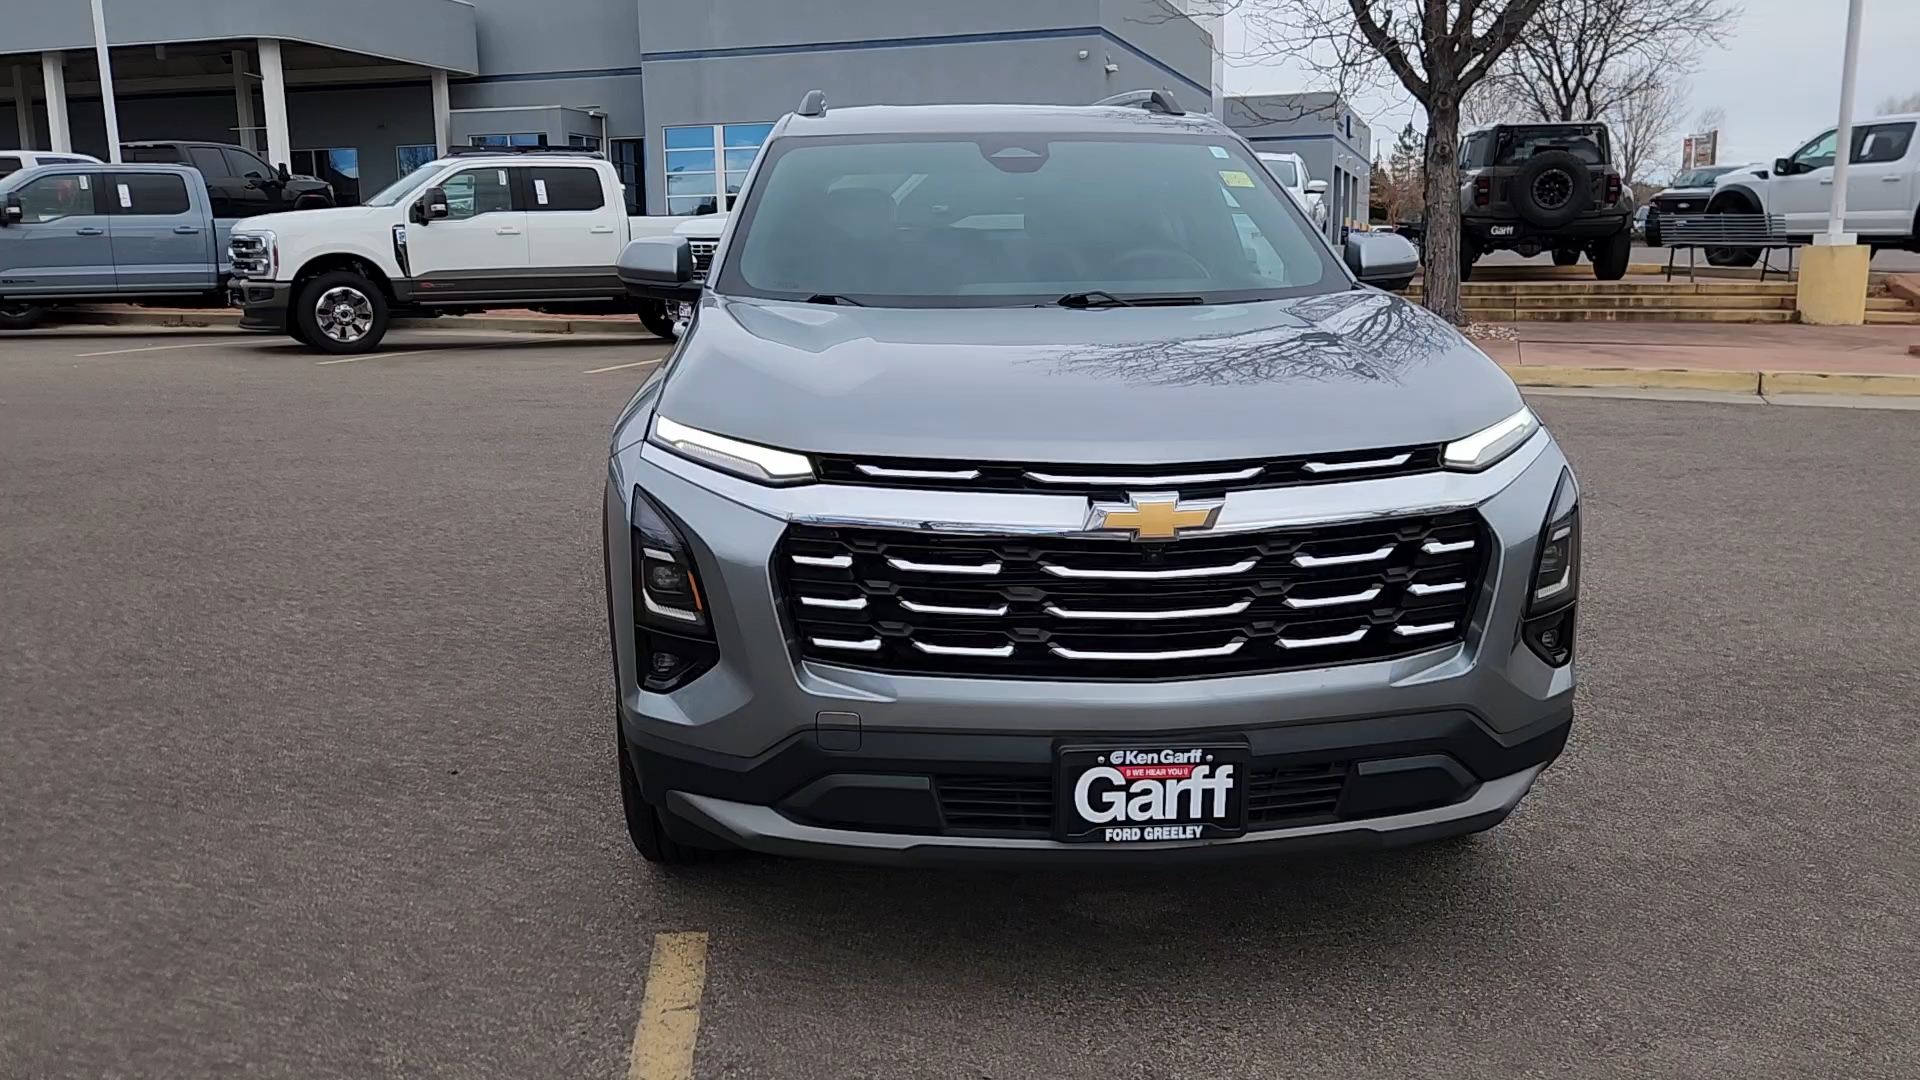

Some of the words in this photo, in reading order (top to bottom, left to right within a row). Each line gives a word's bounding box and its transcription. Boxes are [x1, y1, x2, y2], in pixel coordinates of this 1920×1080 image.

[1125, 750, 1159, 764] Ken
[1160, 749, 1202, 764] Garff
[1132, 768, 1144, 776] WE
[1145, 768, 1166, 776] HEAR
[1167, 768, 1182, 776] YOU
[1074, 765, 1234, 823] Garff
[1105, 828, 1141, 841] FORD
[1143, 826, 1203, 840] GREELEY
